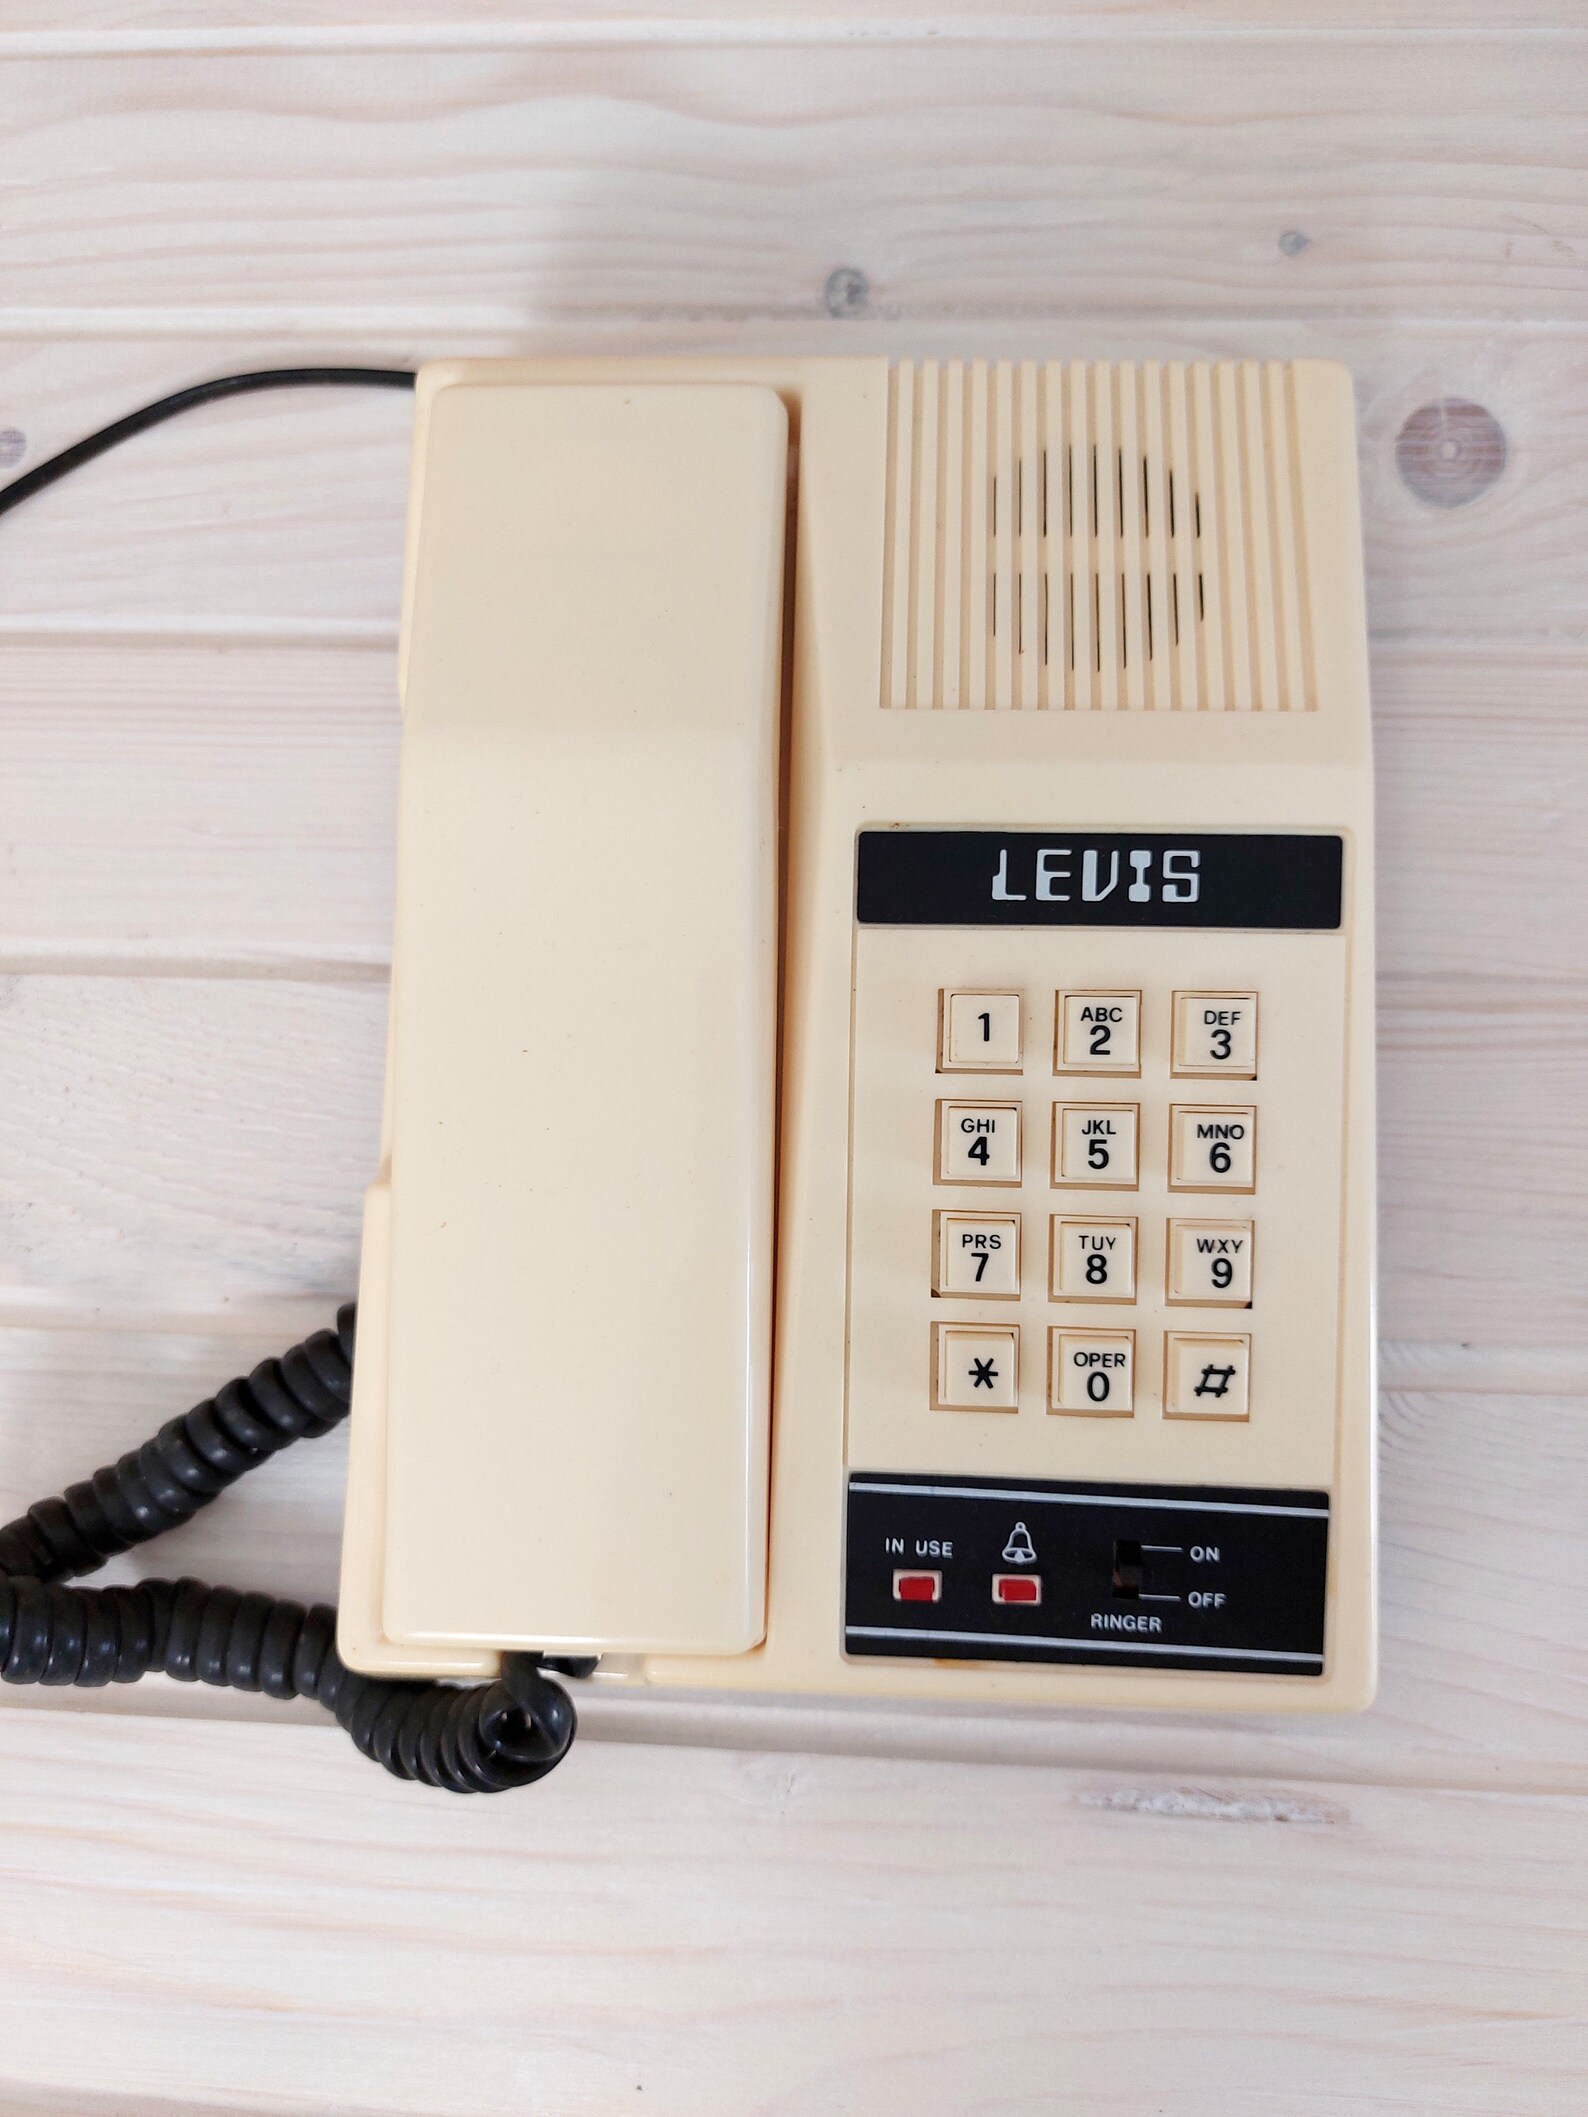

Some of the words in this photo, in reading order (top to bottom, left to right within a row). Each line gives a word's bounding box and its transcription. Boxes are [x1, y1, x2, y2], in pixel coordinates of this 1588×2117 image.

[991, 848, 1200, 903] LEVIS
[1080, 1006, 1123, 1023] ABC
[1204, 1010, 1241, 1026] DEF
[977, 1012, 990, 1042] 1
[1089, 1024, 1111, 1056] 2
[1209, 1028, 1232, 1060] 3
[960, 1117, 995, 1134] GHI
[1081, 1119, 1117, 1136] JKL
[1197, 1123, 1245, 1140] MNO
[967, 1136, 991, 1167] 4
[1087, 1138, 1110, 1170] 5
[1209, 1141, 1232, 1174] 6
[962, 1233, 1002, 1250] PRS
[1078, 1235, 1116, 1251] TUY
[1196, 1238, 1243, 1254] WXY
[970, 1252, 989, 1282] 7
[1085, 1253, 1108, 1285] 8
[1211, 1257, 1233, 1289] 9
[1073, 1351, 1126, 1369] OPER
[1086, 1371, 1110, 1402] 0
[885, 1537, 904, 1554] IN
[915, 1539, 953, 1557] USE
[1189, 1545, 1220, 1562] ON
[1188, 1591, 1225, 1608] OFF
[1090, 1613, 1162, 1632] RINGER
